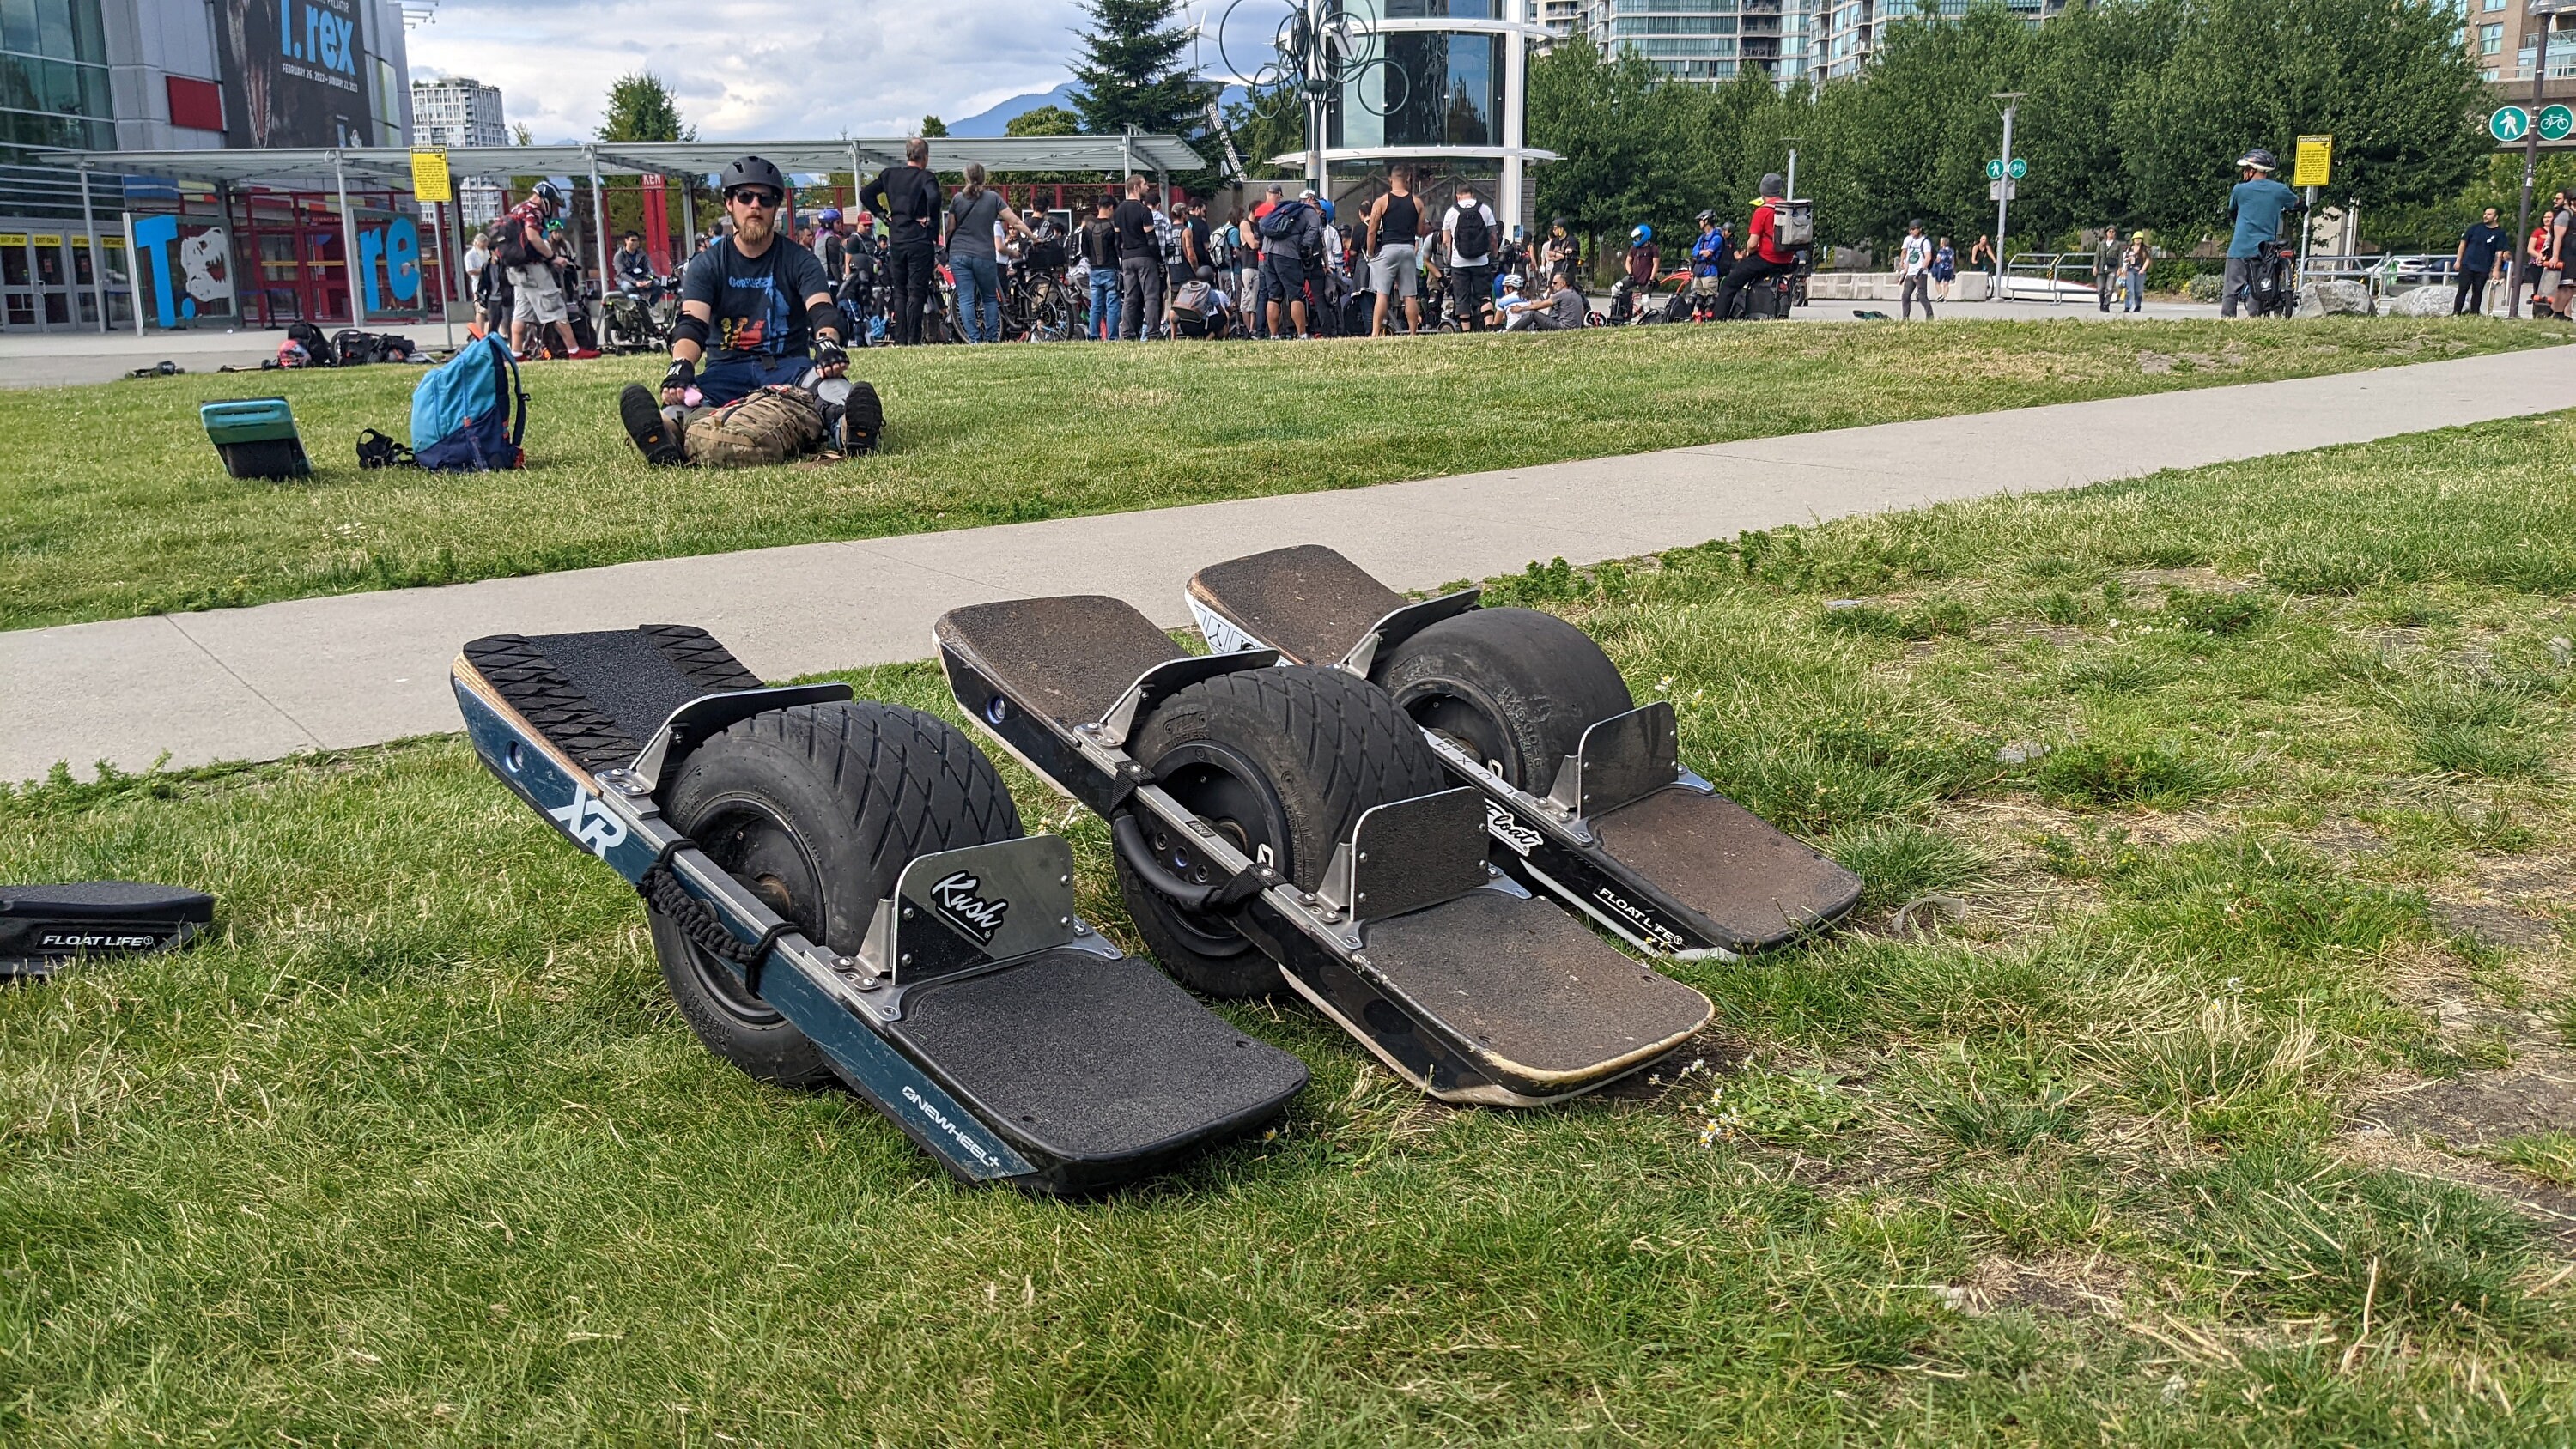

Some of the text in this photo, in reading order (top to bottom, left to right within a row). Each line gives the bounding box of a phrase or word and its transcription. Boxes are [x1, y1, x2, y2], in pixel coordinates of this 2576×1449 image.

[283, 63, 305, 76] FEBRUARY
[548, 782, 628, 859] XR
[932, 872, 1006, 928] Kush
[1600, 888, 1675, 943] FLOAT LFE
[43, 935, 105, 945] FLOAT
